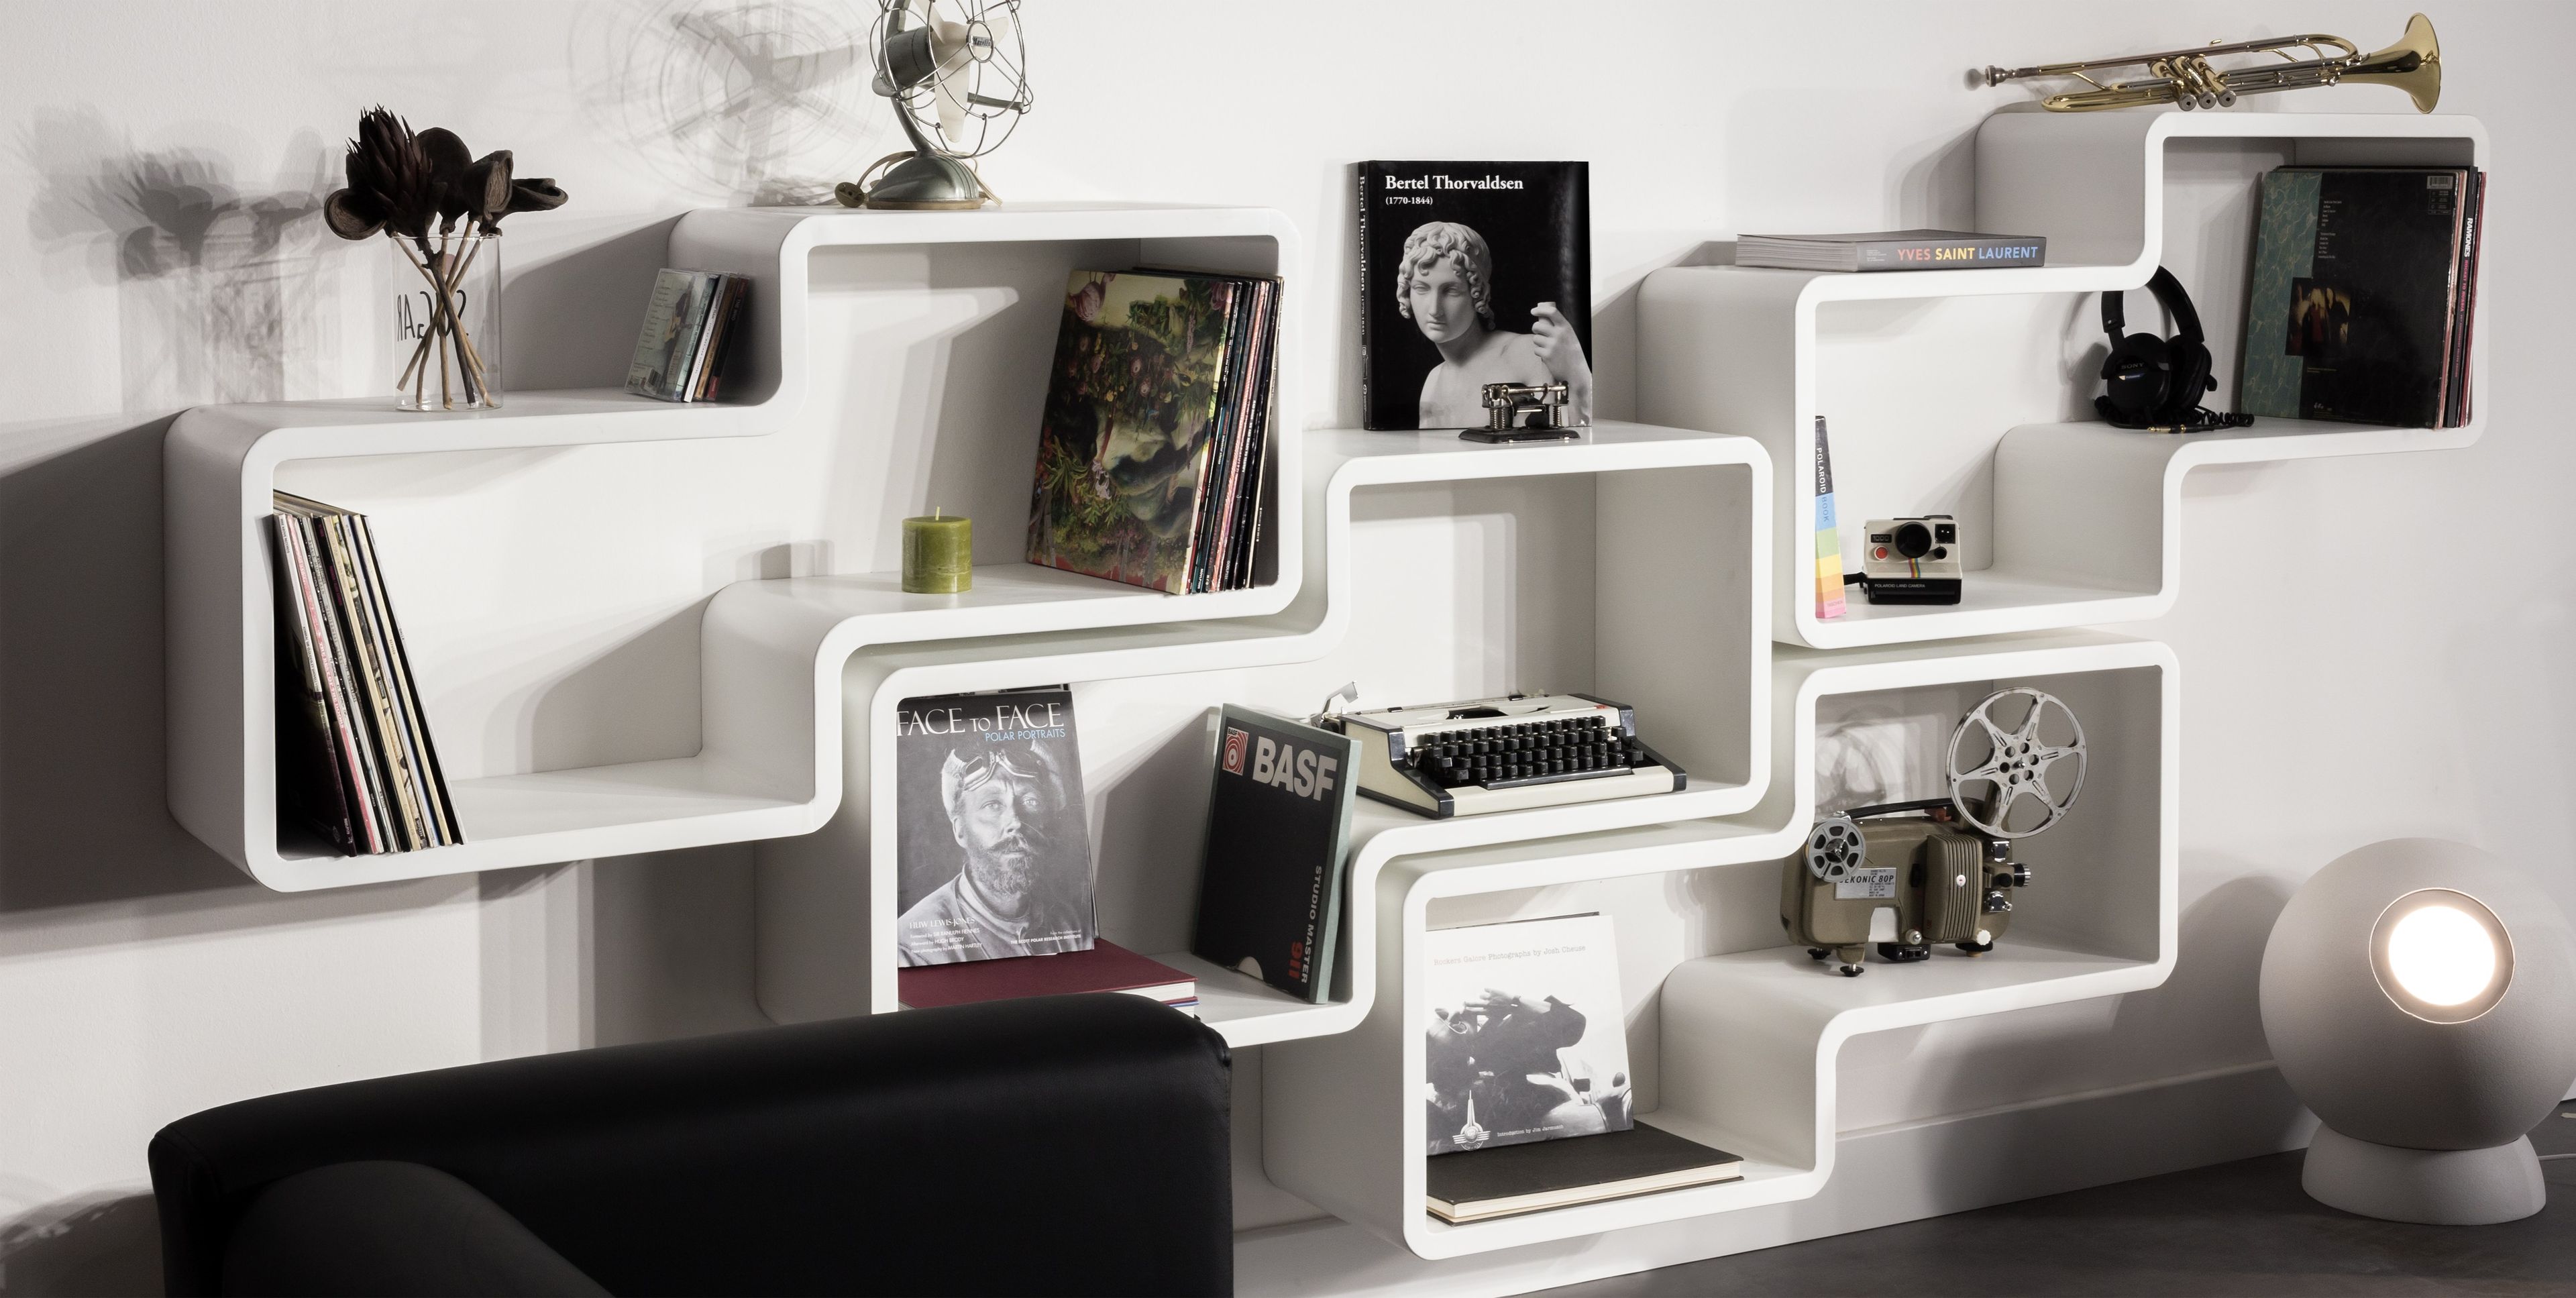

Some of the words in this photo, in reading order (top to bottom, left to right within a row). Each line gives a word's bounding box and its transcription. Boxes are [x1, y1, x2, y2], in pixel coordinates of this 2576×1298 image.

[1385, 175, 1429, 189] Bertel
[1432, 175, 1523, 189] Thorvaldsen
[1385, 196, 1433, 205] (1770-1844)
[2464, 217, 2473, 257] RAMONES
[1897, 248, 1931, 260] YVES
[1935, 248, 1975, 260] SAINT
[1979, 246, 2045, 259] LAURENT
[1817, 447, 1827, 493] POLAROID
[1822, 496, 1830, 522] BOOK
[335, 703, 344, 728] DOORS
[897, 708, 965, 737] FACE
[969, 718, 990, 732] TO
[996, 703, 1064, 731] FACE
[985, 732, 1015, 741] POLAR
[1018, 728, 1066, 739] PORTRAITS
[1252, 736, 1338, 801] BASF
[1839, 875, 1876, 883] EKONIC
[1878, 875, 1894, 883] 80P
[1309, 865, 1322, 920] STUDIO
[910, 921, 928, 929] HUW
[930, 916, 975, 927] LEWIS-JONES
[1288, 940, 1303, 979] 911
[1301, 924, 1314, 983] MASTER
[1434, 958, 1461, 966] Rockers
[1488, 950, 1531, 961] Photographs
[1533, 949, 1542, 957] by
[1544, 947, 1560, 955] Josh
[1562, 944, 1586, 953] Cheuse
[1497, 1129, 1525, 1137] Introduction
